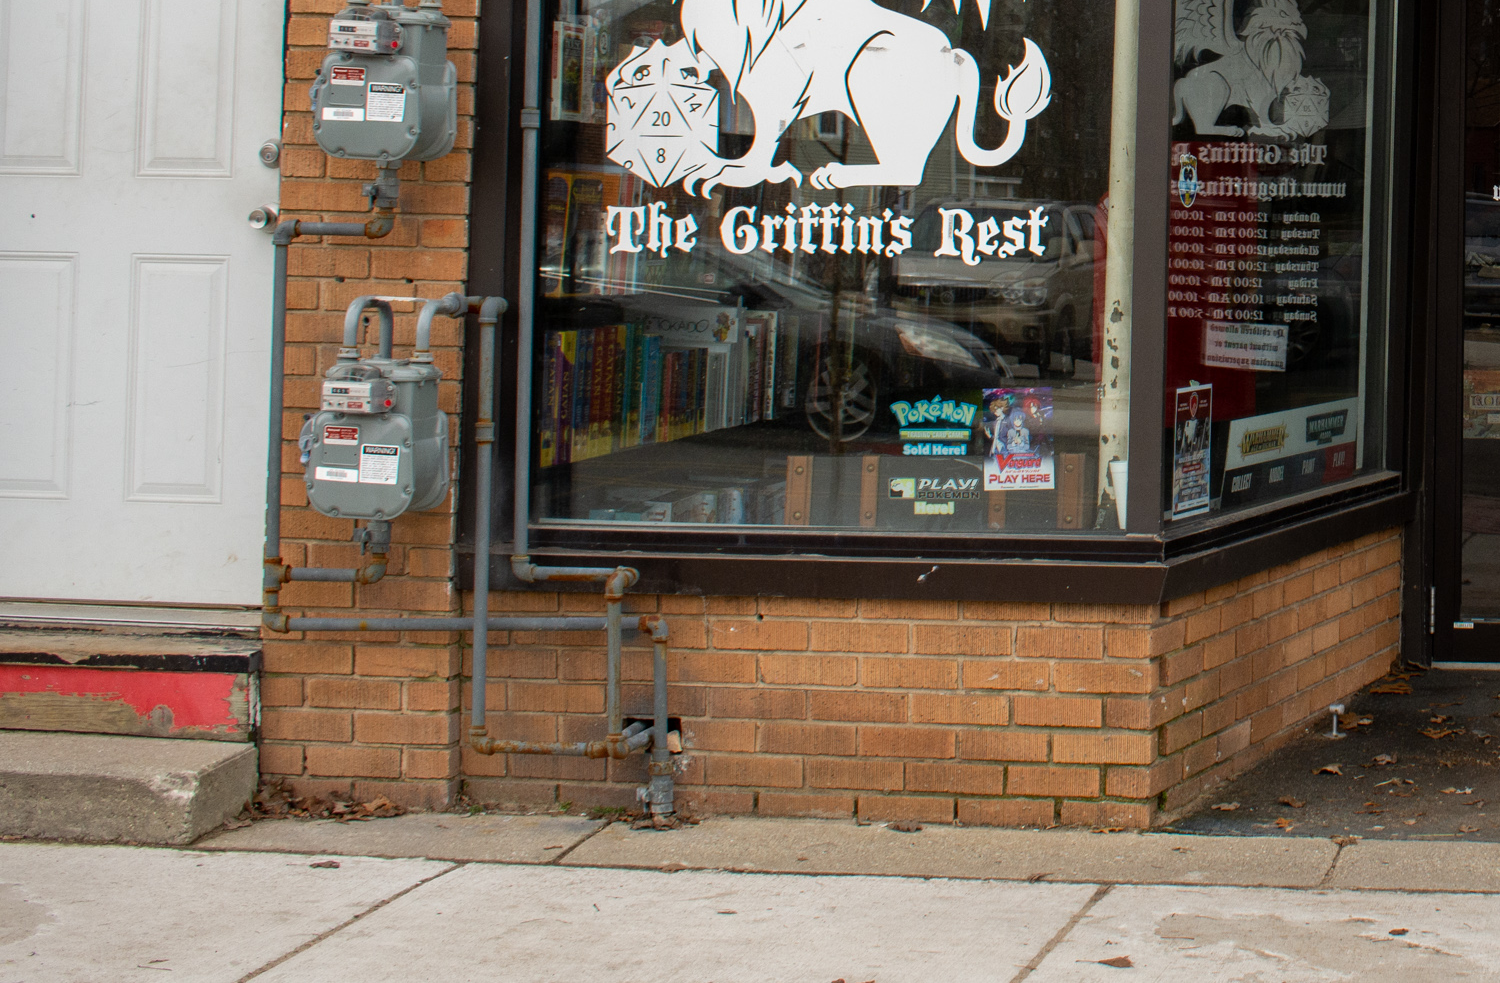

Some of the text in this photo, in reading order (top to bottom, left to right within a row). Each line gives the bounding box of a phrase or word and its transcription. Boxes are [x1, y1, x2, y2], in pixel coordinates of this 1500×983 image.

[372, 85, 403, 93] WARNING!
[621, 92, 702, 128] 2 20 14
[656, 146, 666, 164] 8
[606, 200, 1049, 266] The Griffin's Rest
[1309, 415, 1345, 432] WARHAMMER
[365, 446, 396, 454] WARNING!
[902, 443, 967, 456] Sold Here!
[996, 454, 1042, 473] Vanguard
[918, 478, 979, 490] PLAY!
[988, 474, 1050, 484] PLAY HERE
[1231, 473, 1252, 493] COLLECT
[914, 501, 955, 514] Here!
